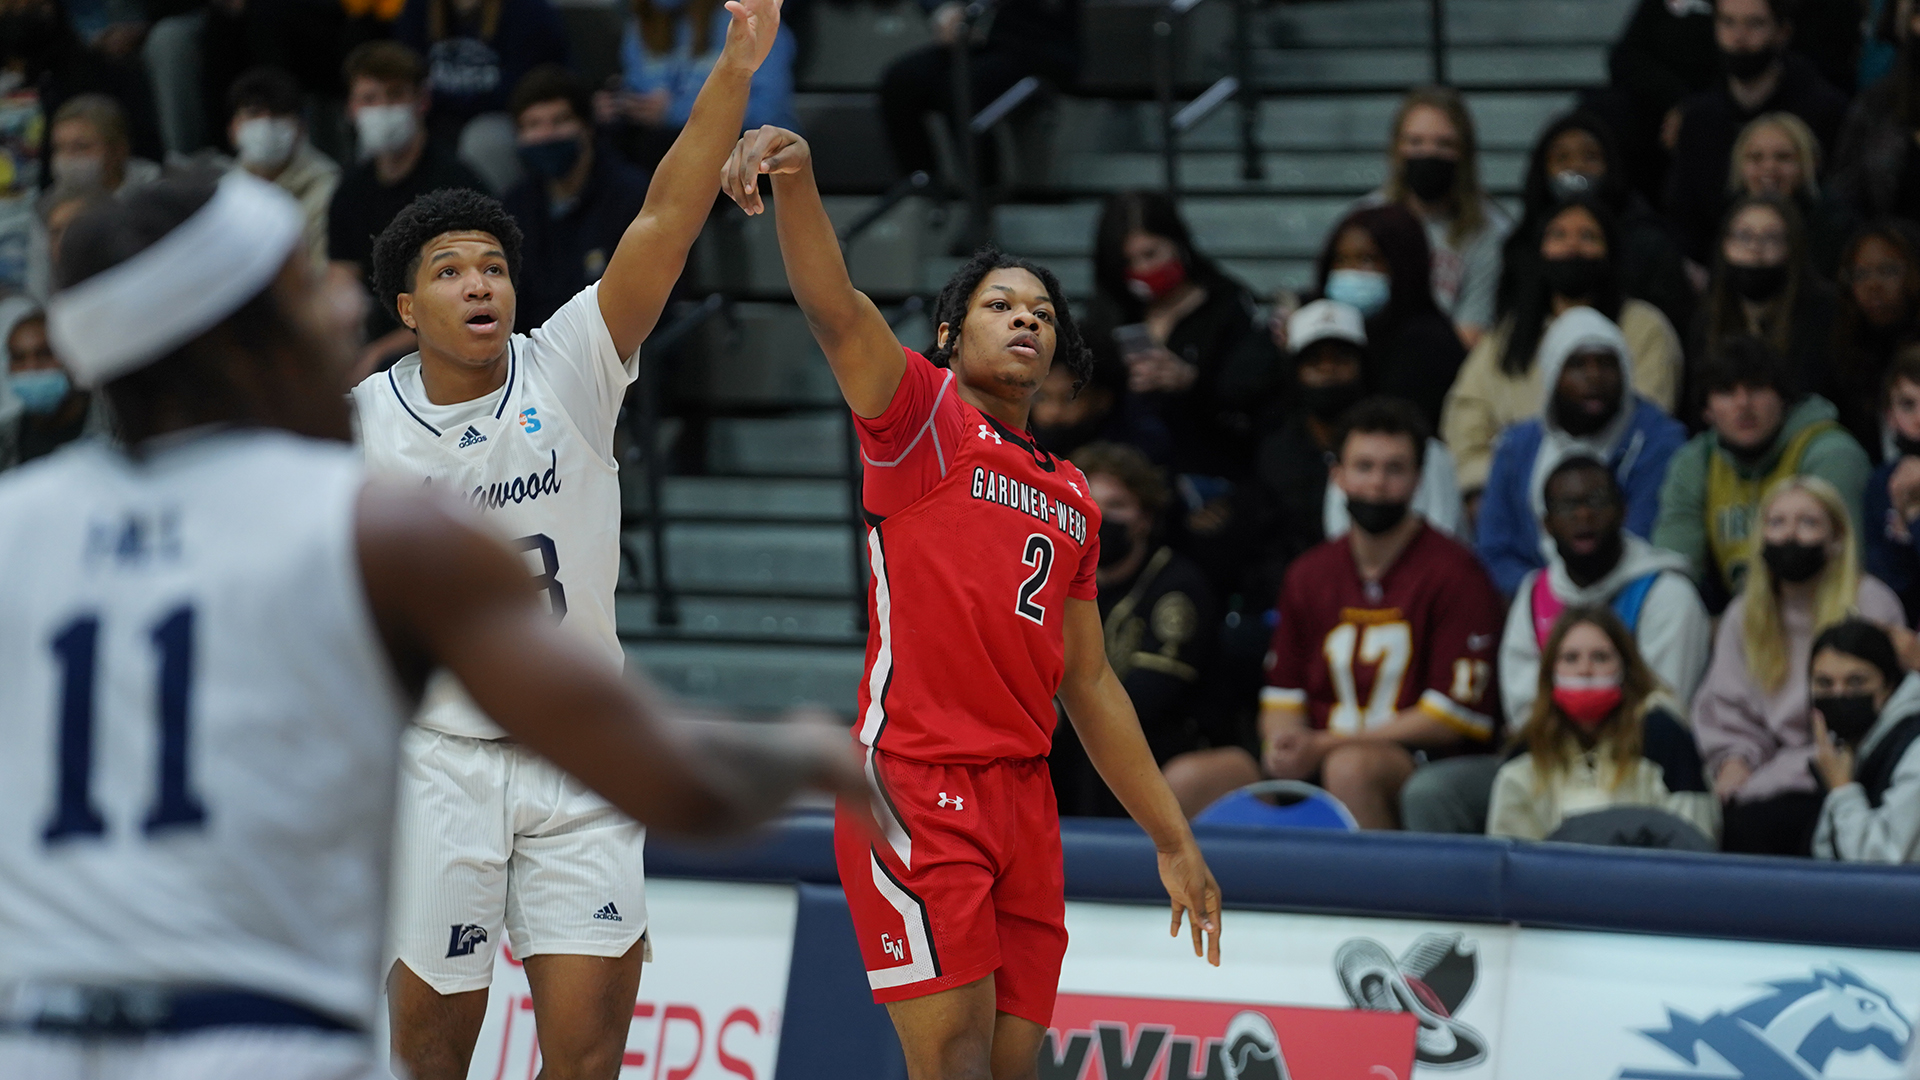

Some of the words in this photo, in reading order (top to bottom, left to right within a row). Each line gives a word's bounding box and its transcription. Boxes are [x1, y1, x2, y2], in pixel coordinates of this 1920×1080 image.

[458, 435, 487, 449] adidas
[971, 466, 1087, 547] GARDNER-WEBB
[1015, 533, 1055, 626] 2
[1324, 620, 1413, 736] 17
[42, 602, 210, 848] 11
[593, 912, 623, 922] adidas
[881, 932, 905, 961] GW
